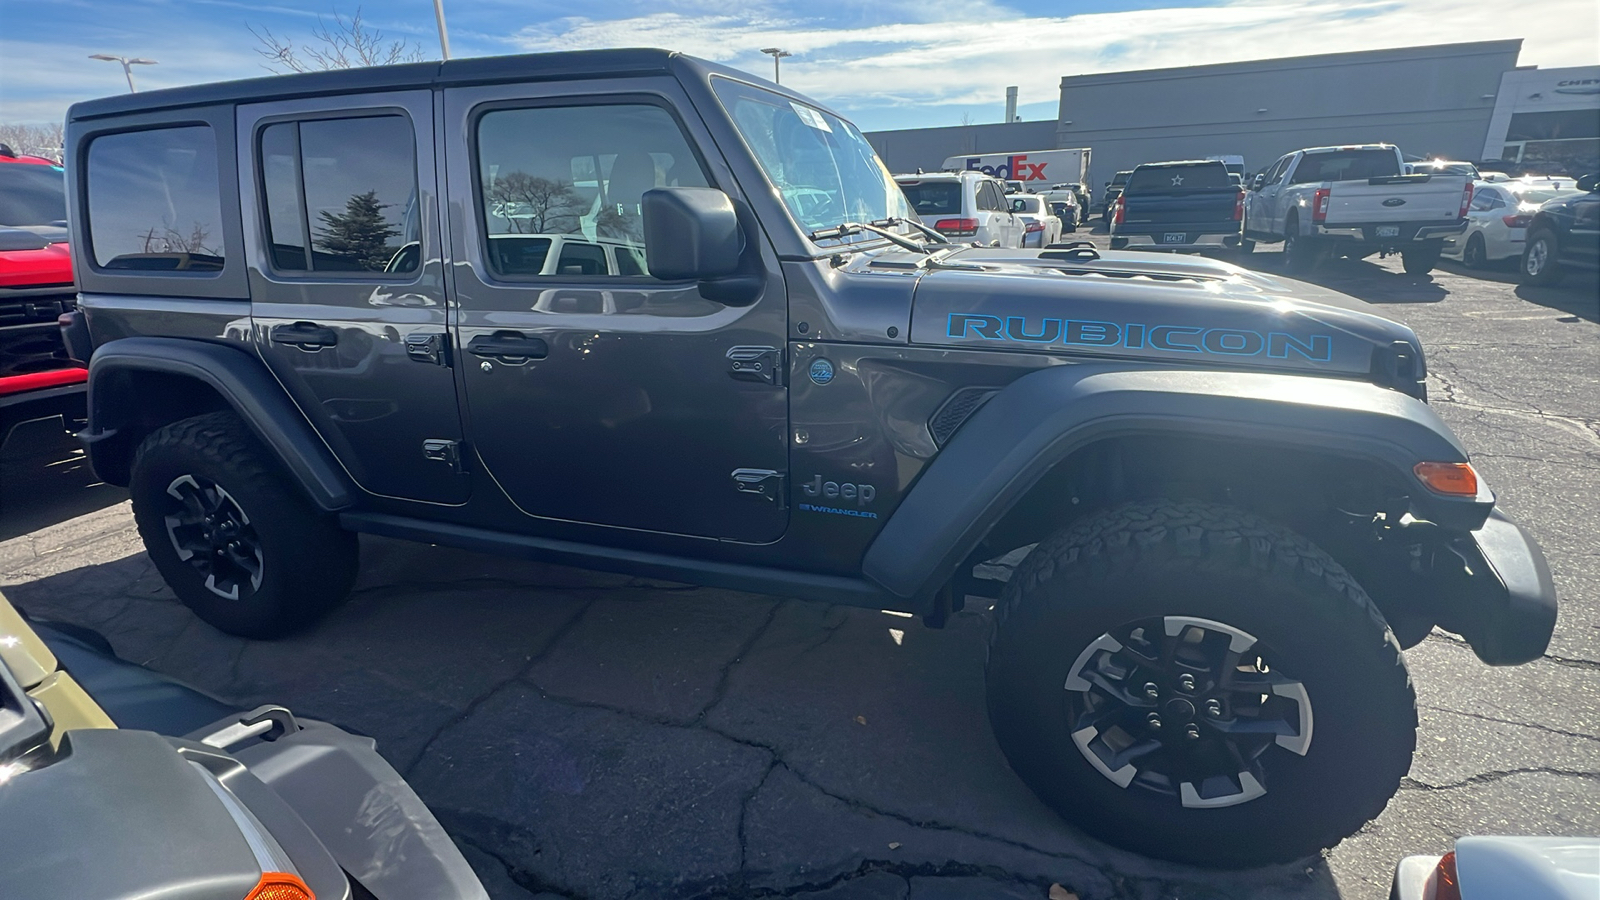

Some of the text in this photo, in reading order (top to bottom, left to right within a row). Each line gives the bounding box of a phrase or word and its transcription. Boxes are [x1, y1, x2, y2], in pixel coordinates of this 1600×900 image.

[966, 155, 1048, 181] FedEx
[946, 312, 1332, 362] RUBICON
[803, 474, 876, 506] Jeep
[810, 504, 878, 519] WRANGLER
